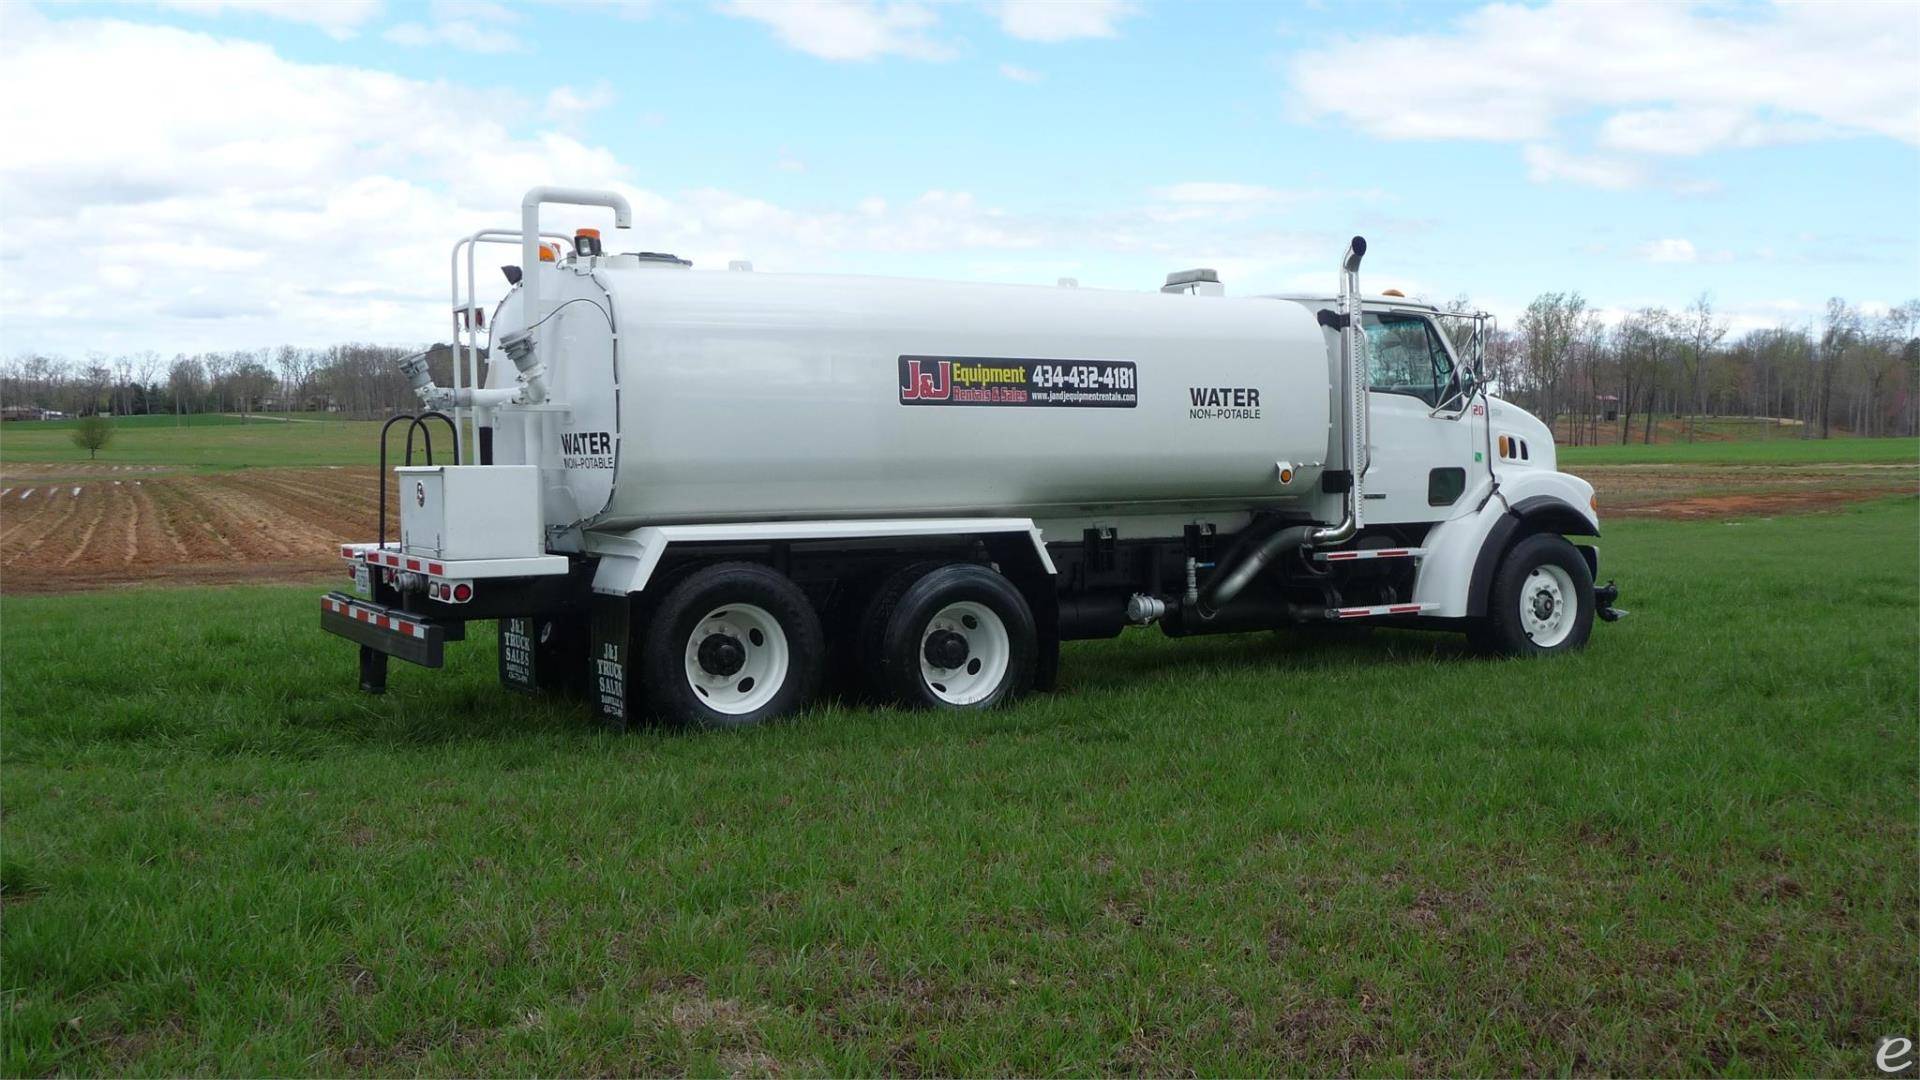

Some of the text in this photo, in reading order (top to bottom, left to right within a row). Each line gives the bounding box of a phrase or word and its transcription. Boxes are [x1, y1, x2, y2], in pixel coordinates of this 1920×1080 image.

[901, 360, 950, 400] J&J
[952, 363, 1026, 386] Equipment
[1032, 365, 1134, 389] 434-432-4181
[952, 386, 1028, 403] Rentals & Sales
[1031, 390, 1136, 403] www.jandjequipmentrentals.com
[1190, 388, 1260, 407] WATER
[1189, 408, 1261, 420] NON-POTABLE
[561, 431, 611, 455] WATER
[563, 457, 614, 470] NON-POTABLE
[504, 631, 530, 652] TRUCK
[505, 647, 530, 666] SALES
[603, 643, 618, 662] J&J
[597, 659, 623, 681] TRUCK
[599, 676, 623, 698] SALES
